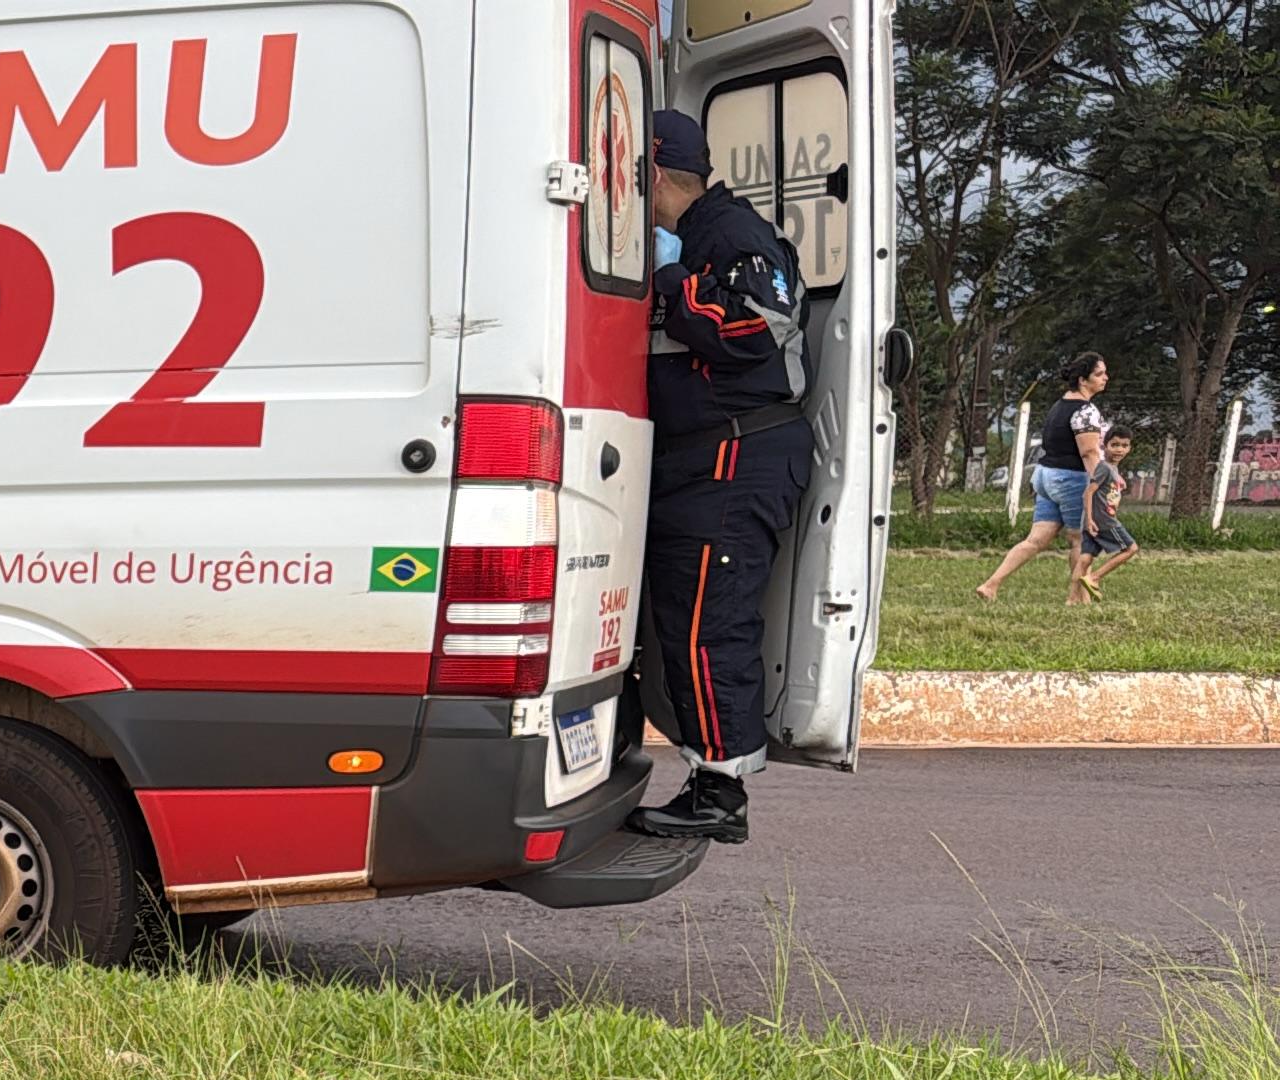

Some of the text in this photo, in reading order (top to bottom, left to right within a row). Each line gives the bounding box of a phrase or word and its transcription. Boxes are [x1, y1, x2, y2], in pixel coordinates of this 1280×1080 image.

[113, 551, 156, 584] de
[170, 550, 334, 591] Urgência
[598, 586, 630, 617] SAMU
[600, 616, 622, 650] 192
